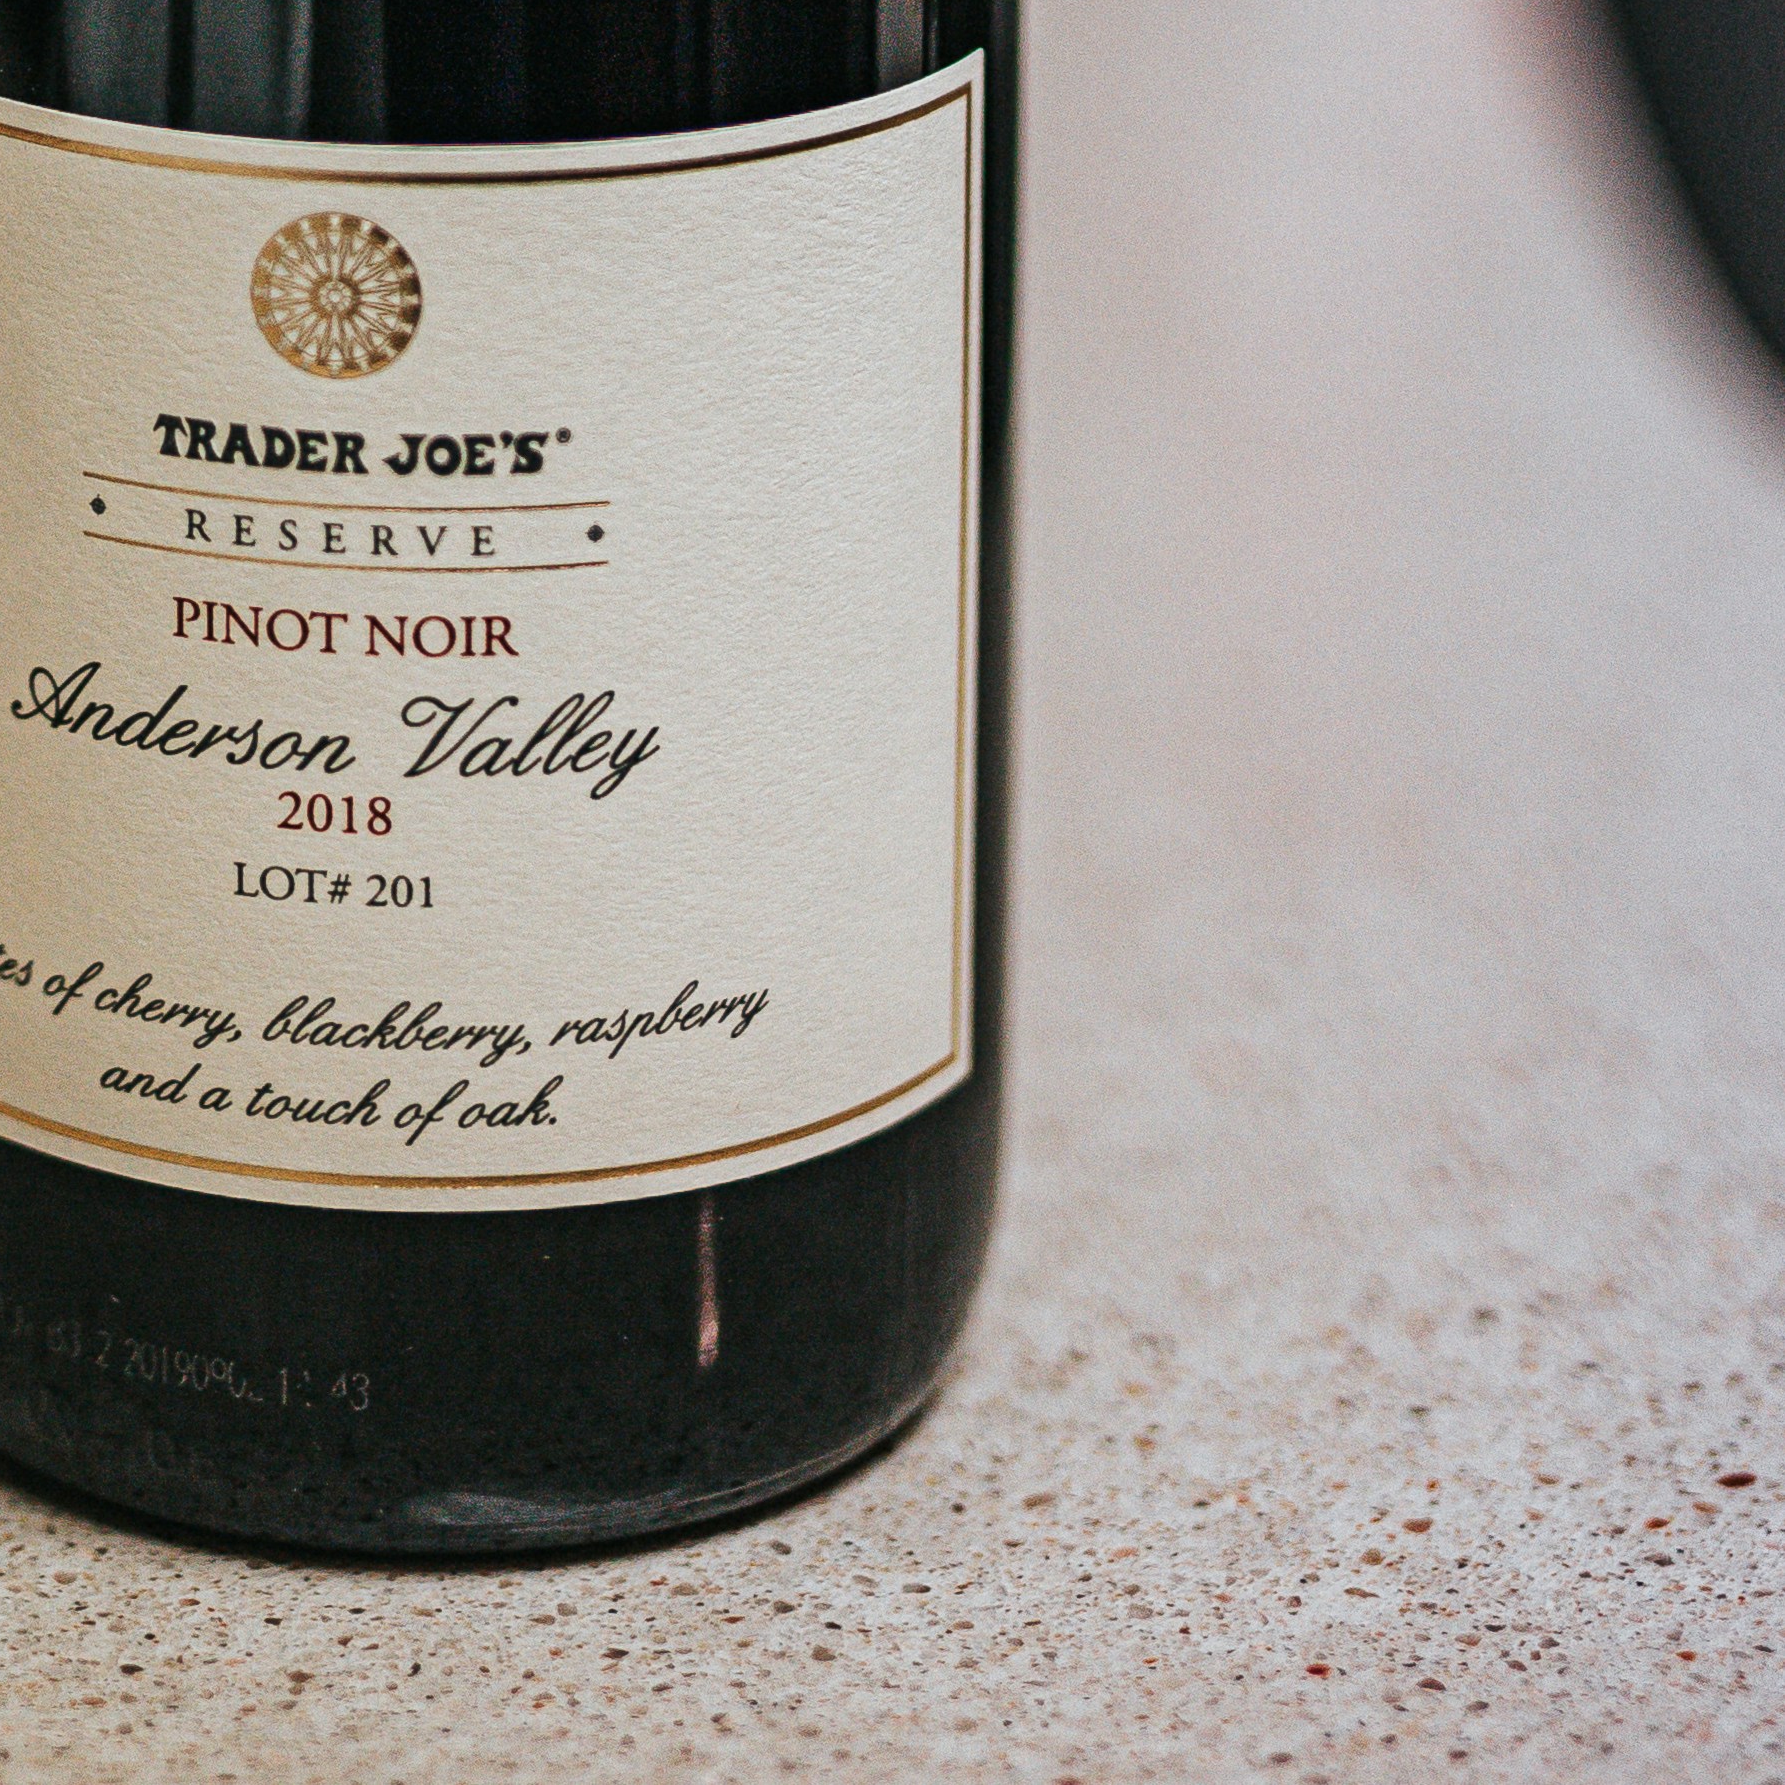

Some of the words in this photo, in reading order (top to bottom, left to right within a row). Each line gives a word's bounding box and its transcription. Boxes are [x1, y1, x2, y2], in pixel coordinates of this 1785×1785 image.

[153, 413, 369, 475] TRADER
[184, 508, 496, 557] RESERVE
[172, 596, 348, 655] PINOT
[364, 614, 519, 658] NOIR
[11, 661, 356, 774] Anderson
[401, 690, 660, 800] Valley
[276, 791, 393, 836] 2018
[232, 862, 352, 905] LOT#
[365, 874, 435, 909] 201
[43, 961, 105, 1015] of
[94, 973, 242, 1049] cherry,
[262, 995, 532, 1067] blackberry,
[549, 979, 769, 1059] raspberry
[100, 1063, 202, 1104] and
[198, 1083, 232, 1111] a
[245, 1078, 391, 1129] touch
[393, 1079, 470, 1146] of
[458, 1075, 564, 1126] oak.
